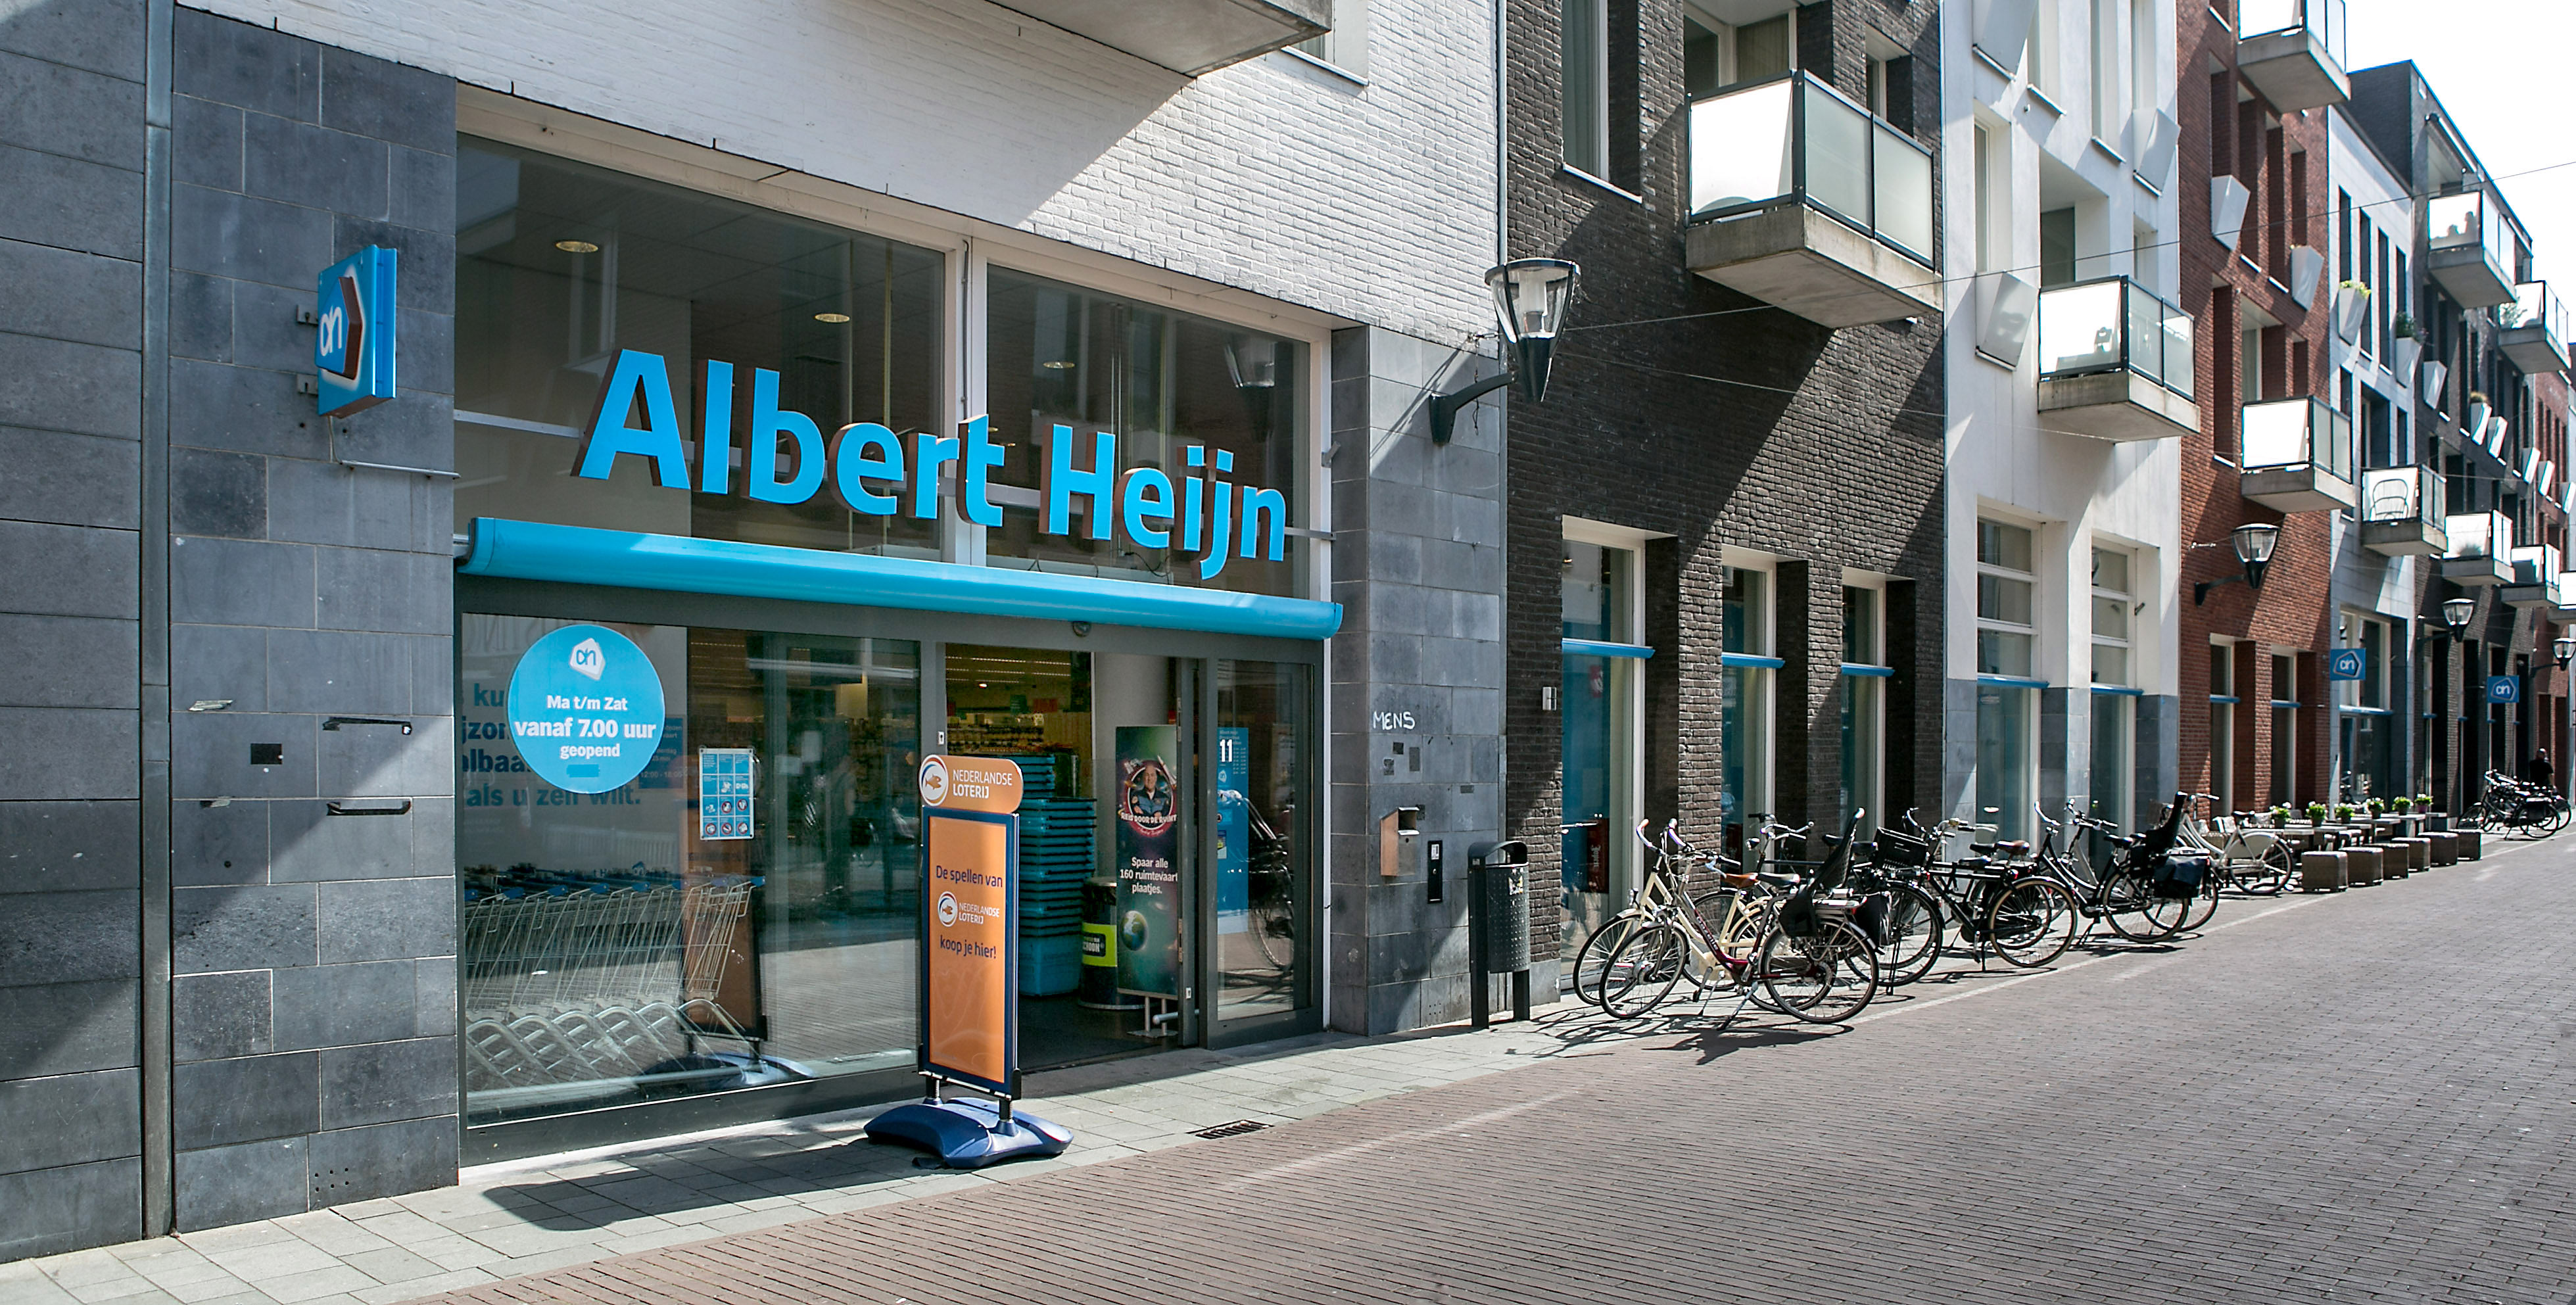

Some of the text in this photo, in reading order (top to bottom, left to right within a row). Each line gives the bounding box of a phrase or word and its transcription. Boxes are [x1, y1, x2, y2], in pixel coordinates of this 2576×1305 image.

[571, 348, 1287, 581] Albert Heijn
[546, 695, 629, 711] Ma t/m Zat
[515, 717, 657, 739] vanaf 7.00 uur
[1373, 711, 1416, 730] MENS
[560, 744, 621, 760] geopend
[1219, 738, 1233, 763] 11
[953, 769, 1013, 786] NEDERLANDSE
[466, 783, 504, 807] als
[513, 789, 527, 806] u
[953, 783, 990, 799] LOTERIJ
[1134, 815, 1150, 824] DOOR
[1131, 857, 1168, 868] Spaar alle
[936, 865, 1003, 888] De spellen van
[1120, 869, 1133, 879] 160
[1132, 883, 1162, 895] plaatjes.
[958, 911, 984, 925] LOTERIJ
[959, 902, 1000, 918] NEDERLANDSE
[940, 934, 997, 959] koop je hier!
